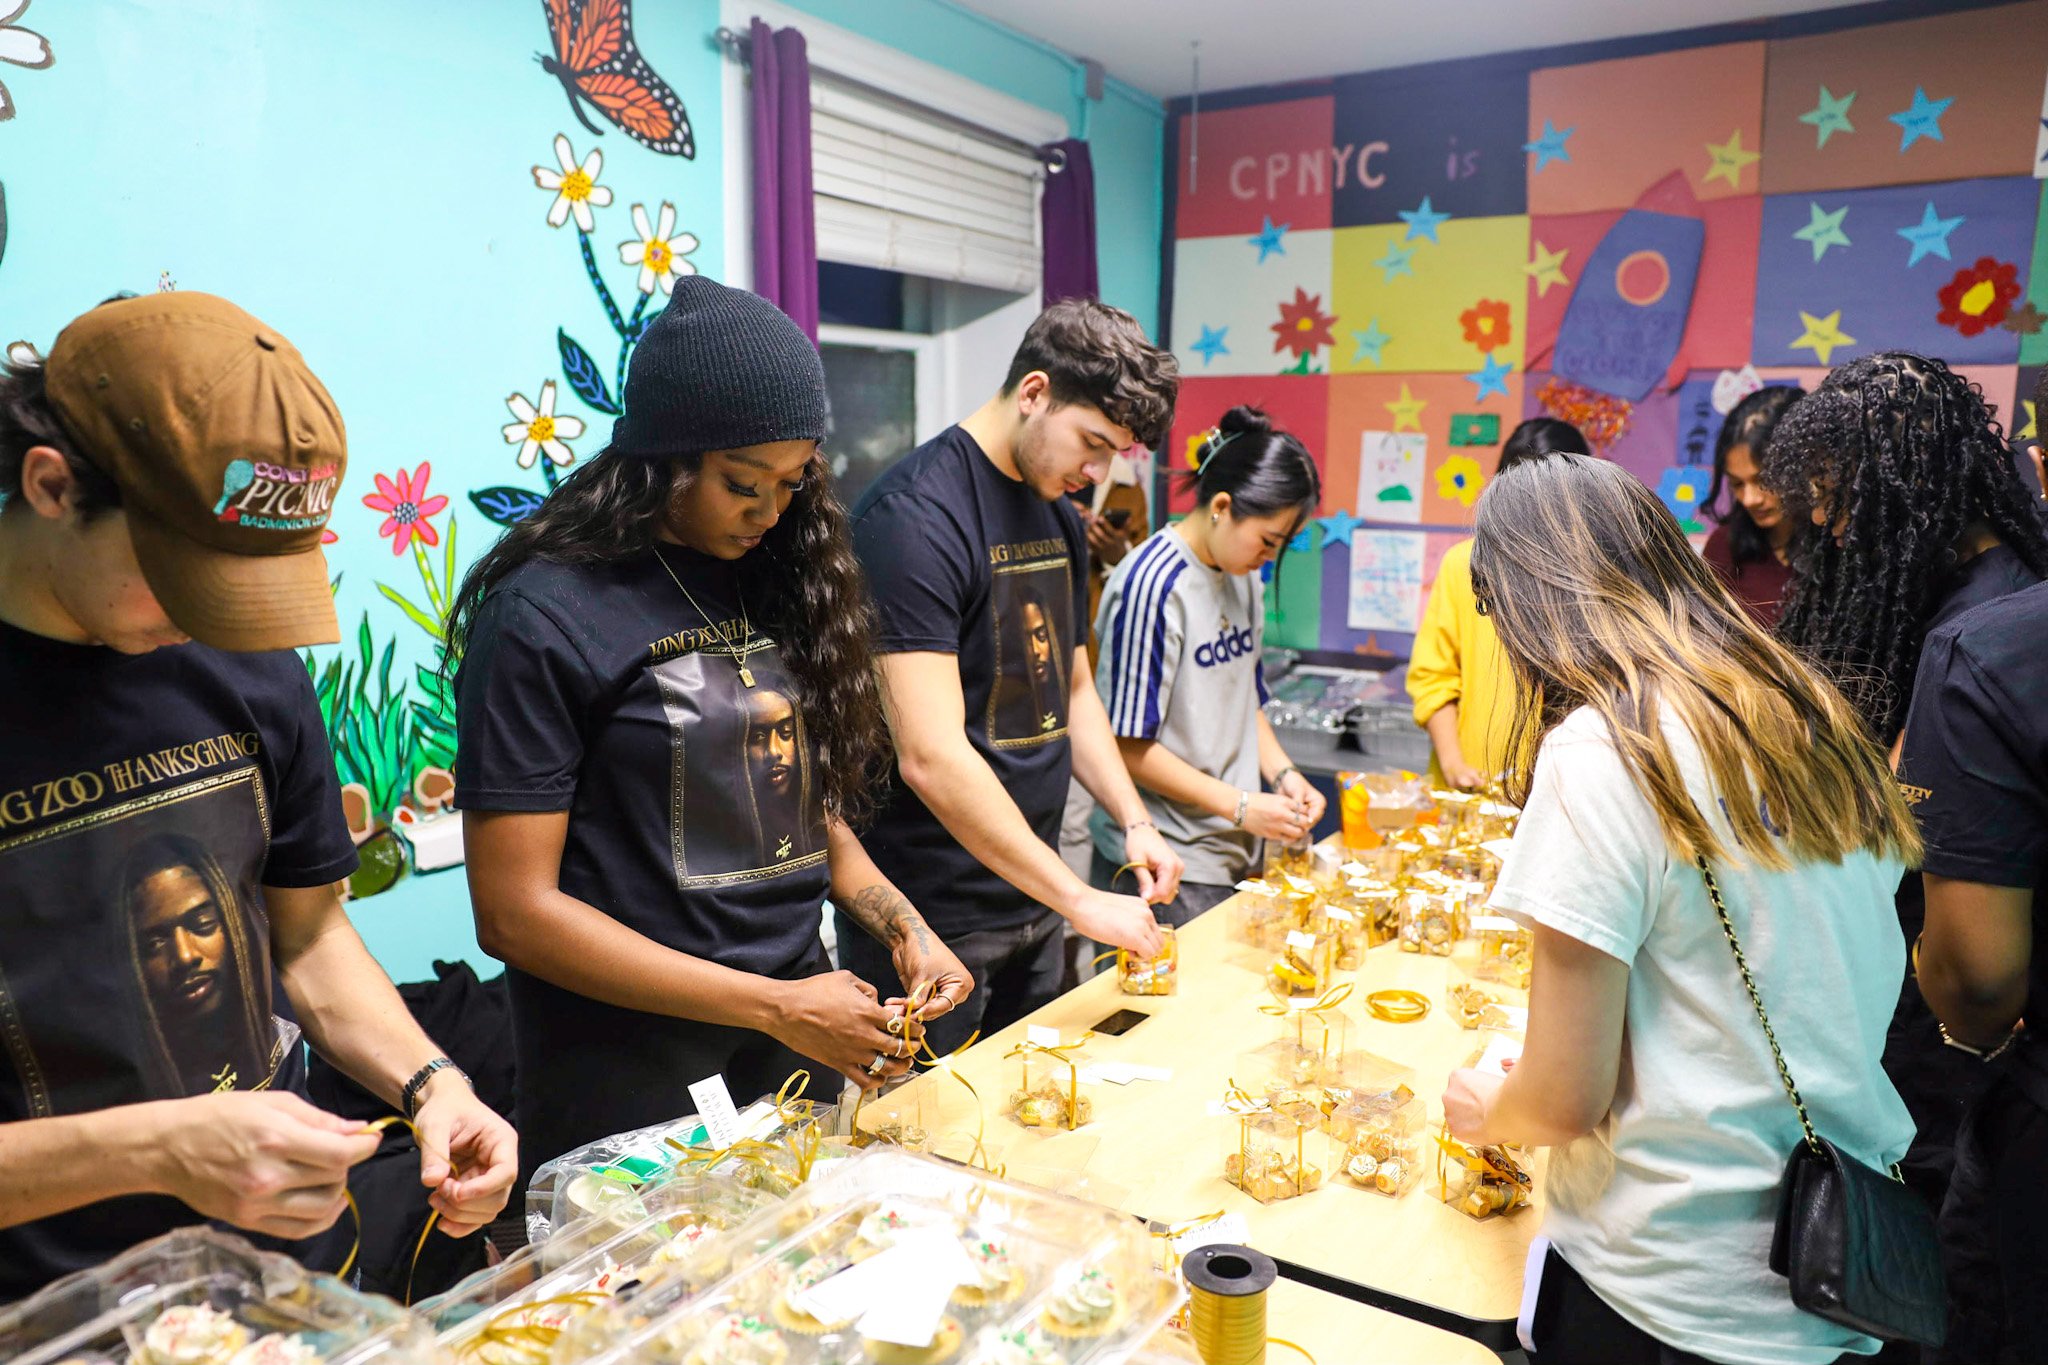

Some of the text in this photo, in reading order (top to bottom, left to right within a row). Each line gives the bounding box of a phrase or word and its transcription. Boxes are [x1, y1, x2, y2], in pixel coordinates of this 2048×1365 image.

[1229, 137, 1480, 200] CPNYC is
[235, 477, 336, 515] PICNIC
[33, 772, 104, 817] ZOO
[104, 732, 260, 793] THANKSGIVING
[1898, 782, 1932, 800] ETTY
